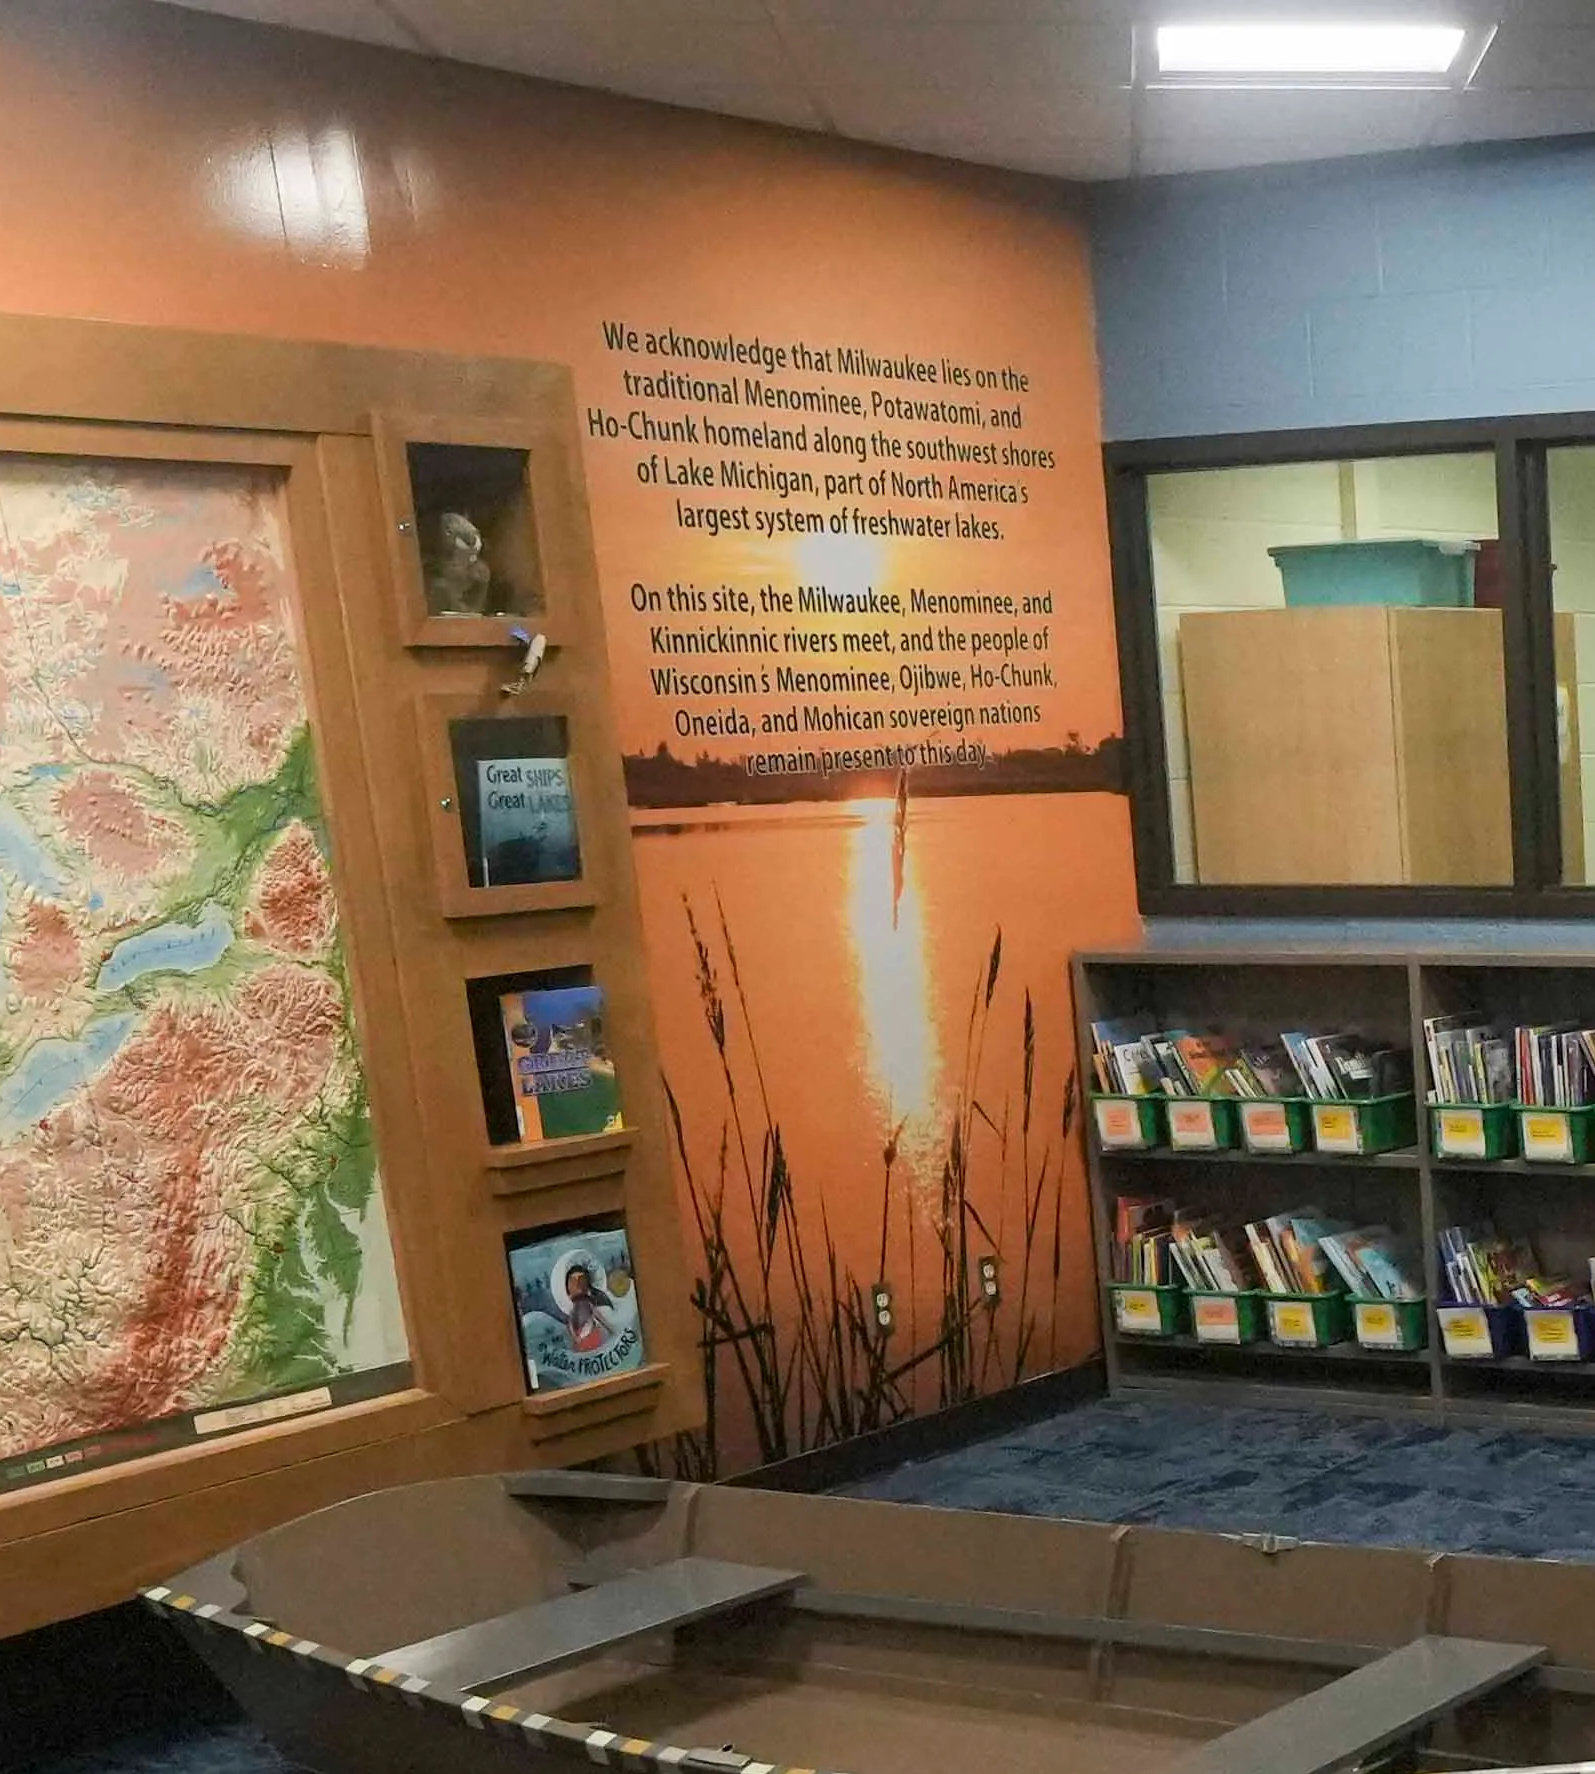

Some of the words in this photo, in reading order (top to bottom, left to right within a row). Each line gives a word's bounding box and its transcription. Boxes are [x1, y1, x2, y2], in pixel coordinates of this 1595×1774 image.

[603, 321, 638, 352] We
[645, 326, 786, 373] acknowledge
[791, 343, 832, 372] that
[838, 348, 937, 384] Milwaukee
[942, 360, 971, 387] lies
[975, 368, 997, 388] on
[1002, 369, 1029, 392] the
[624, 370, 738, 404] traditional
[745, 379, 867, 419] Menominee,
[872, 392, 985, 428] Potawatomi,
[991, 403, 1021, 429] and
[588, 409, 698, 444] Ho-Chunk
[704, 416, 807, 452] homeland
[814, 426, 866, 463] along
[871, 432, 902, 458] the
[907, 437, 997, 466] southwest
[1002, 445, 1055, 469] shores
[637, 455, 659, 484] of
[665, 459, 713, 486] Lake
[721, 462, 818, 498] Michigan,
[825, 471, 863, 499] part
[868, 471, 887, 497] of
[892, 473, 943, 499] North
[677, 500, 750, 537] largest
[756, 510, 825, 538] system
[830, 507, 848, 533] of
[853, 509, 951, 538] freshwater
[955, 514, 1004, 540] lakes.
[630, 582, 661, 614] On
[667, 584, 706, 612] this
[713, 586, 755, 617] site,
[760, 586, 793, 612] the
[798, 587, 906, 617] Milwaukee,
[910, 589, 1018, 616] Menominee,
[1023, 591, 1052, 614] and
[650, 627, 778, 654] Kinnickinnic
[783, 629, 838, 654] rivers
[843, 631, 896, 656] meet,
[900, 629, 933, 652] and
[938, 629, 966, 651] the
[971, 628, 1028, 655] people
[1033, 626, 1050, 649] of
[777, 667, 895, 695] Menominee,
[900, 667, 966, 696] Ojibwe,
[675, 707, 756, 738] Oneida,
[762, 709, 798, 733] and
[803, 707, 884, 732] Mohican
[889, 706, 975, 731] sovereign
[979, 700, 1041, 725] nations
[486, 765, 521, 784] Great
[747, 749, 816, 775] remain
[821, 748, 893, 775] present
[898, 746, 915, 767] to
[920, 740, 952, 766] this
[488, 790, 525, 810] Great
[578, 1327, 637, 1376] PROTECTORS
